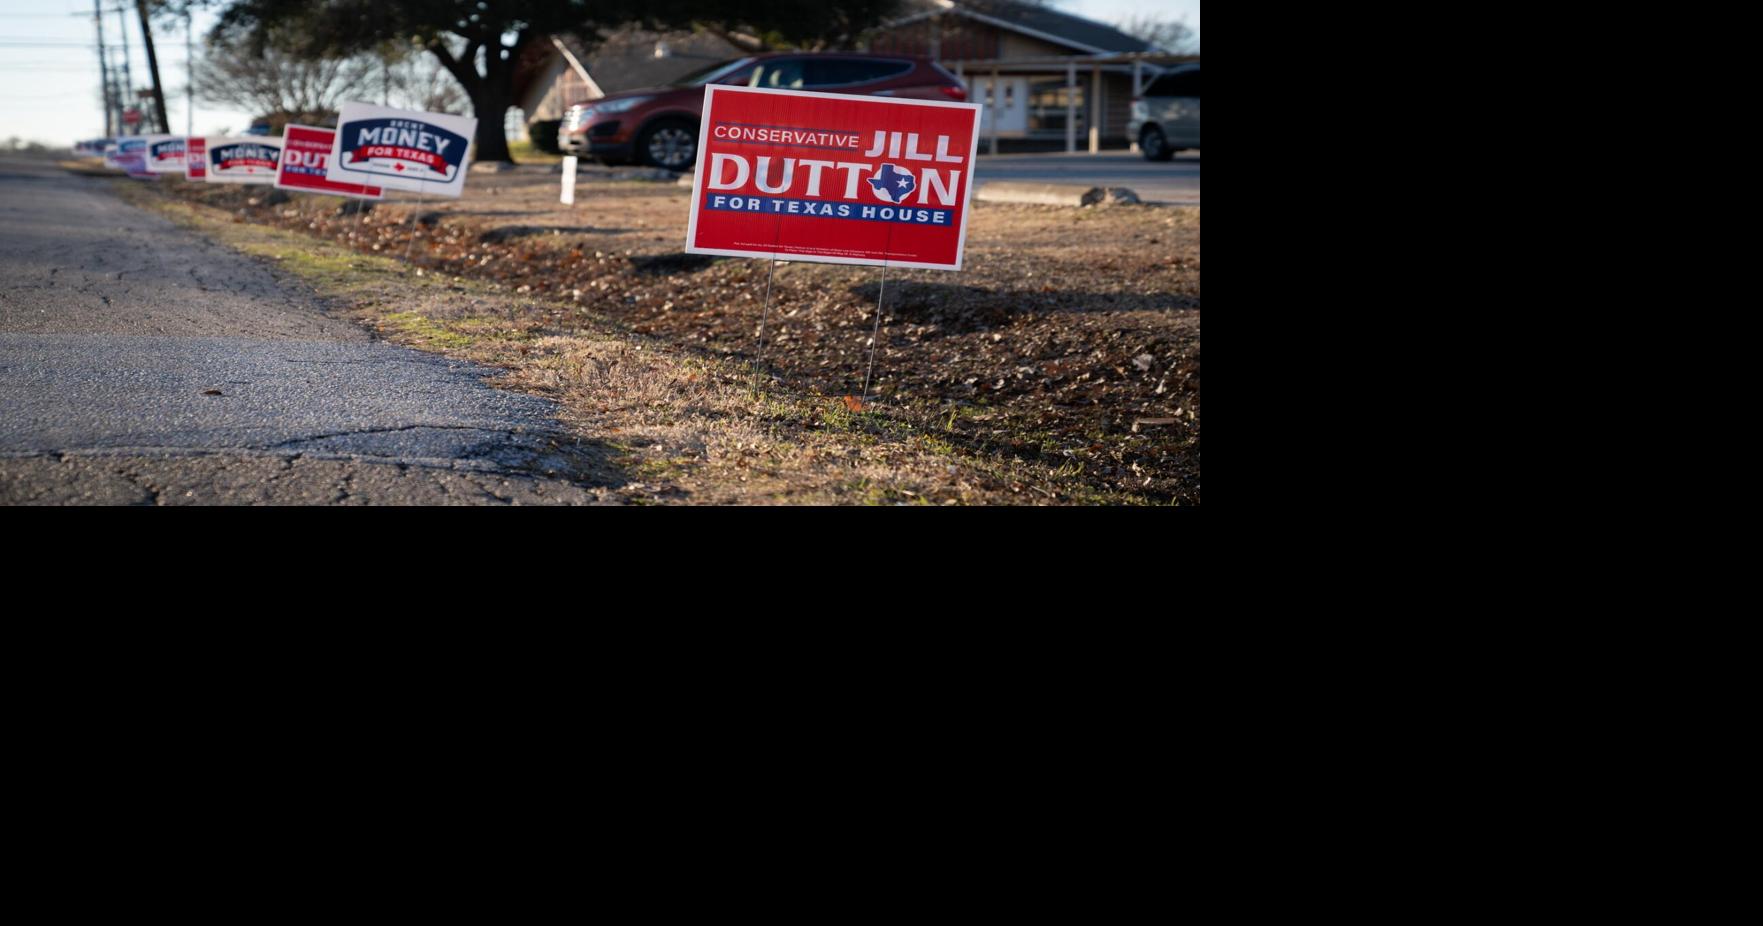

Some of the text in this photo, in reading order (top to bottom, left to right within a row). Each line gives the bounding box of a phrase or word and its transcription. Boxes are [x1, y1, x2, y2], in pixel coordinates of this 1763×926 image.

[220, 147, 278, 161] MONEY
[357, 126, 451, 155] MONEY
[714, 125, 964, 163] CONSERVATIVE JILL
[367, 146, 435, 164] FOR TEXAS
[707, 152, 962, 207] DUTTON
[713, 196, 945, 223] FOR TEXAS HOUSE
